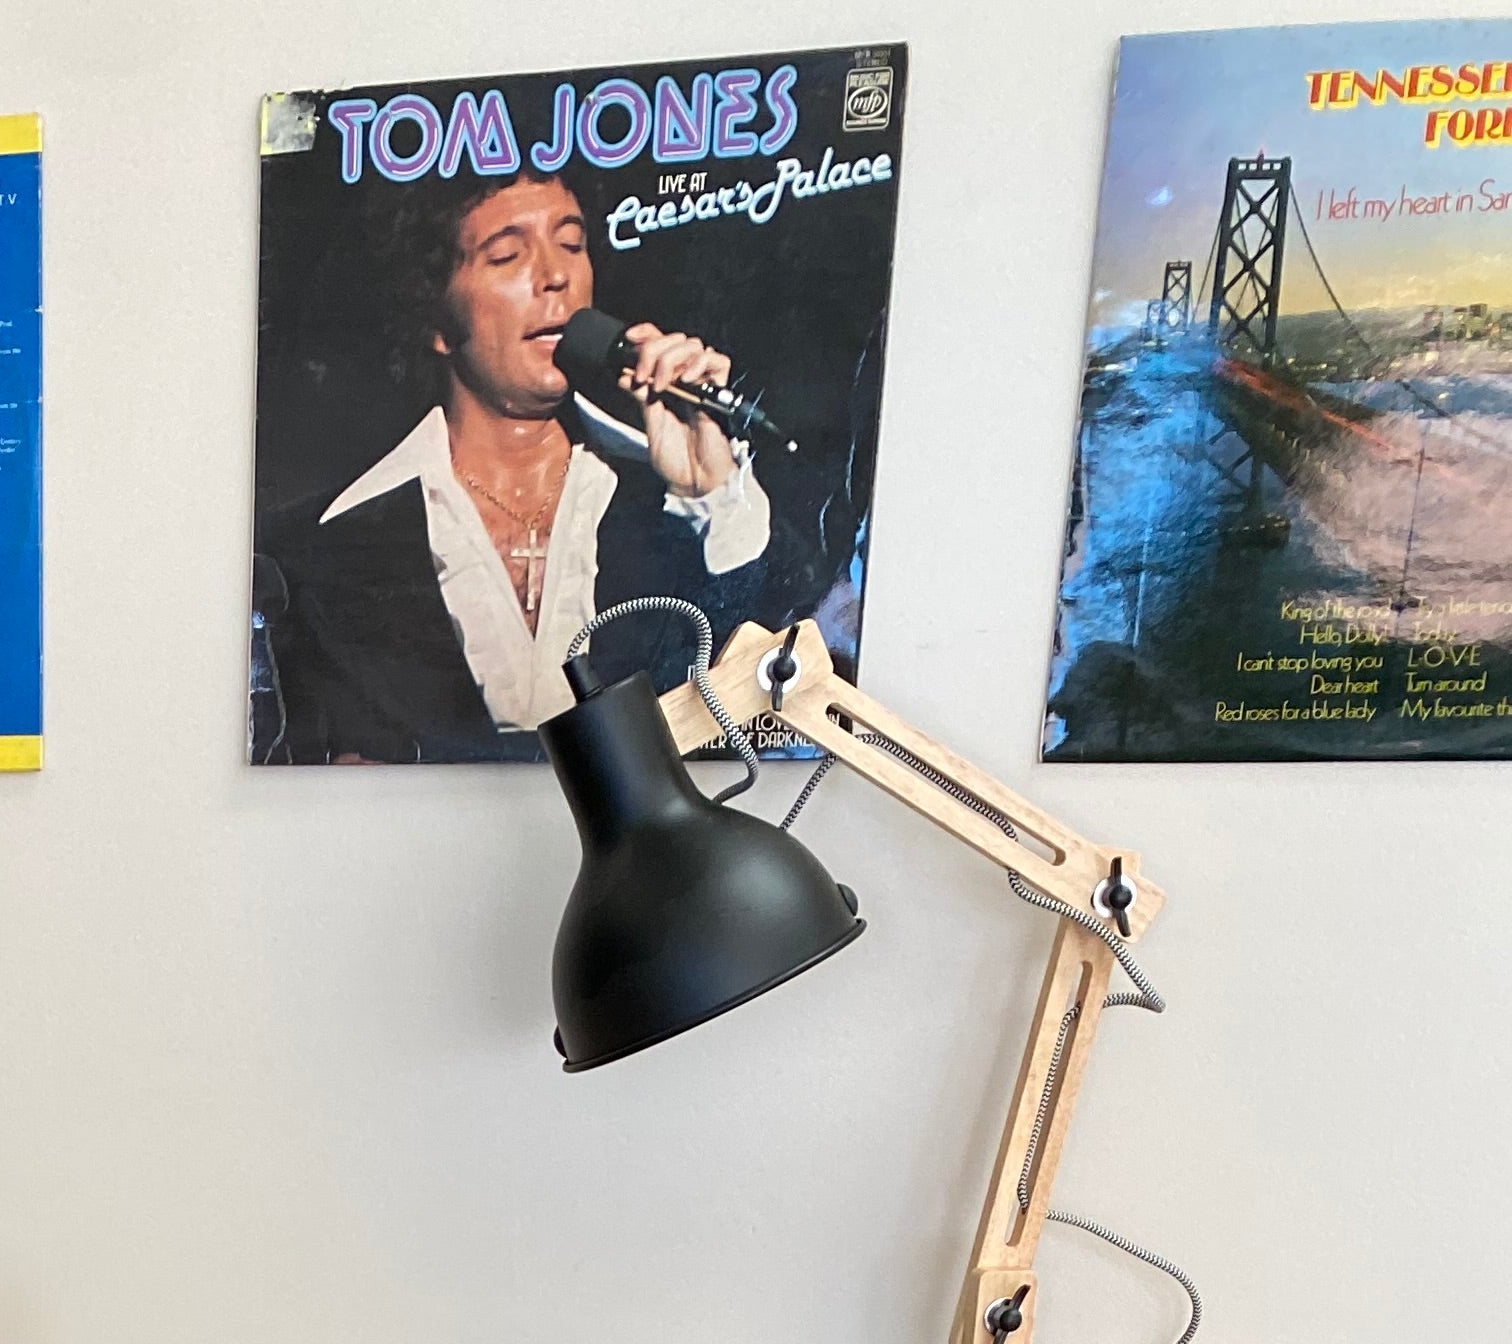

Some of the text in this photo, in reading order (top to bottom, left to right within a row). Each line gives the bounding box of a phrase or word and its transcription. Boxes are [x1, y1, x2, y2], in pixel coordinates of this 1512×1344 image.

[853, 89, 882, 113] mfp
[327, 64, 798, 184] TOM JONES
[658, 171, 707, 195] LIVE AT
[8, 193, 17, 205] V
[605, 146, 892, 251] Caesar's Palace
[1317, 189, 1323, 221] I
[1329, 186, 1360, 219] left
[1363, 198, 1396, 222] my
[1399, 185, 1451, 216] heart
[1456, 189, 1473, 213] in
[1281, 601, 1312, 622] King
[1244, 651, 1273, 671] can't
[1278, 656, 1308, 673] stop
[1311, 650, 1351, 672] loving
[1355, 657, 1383, 671] you
[1310, 674, 1379, 694] Dear heart
[1215, 699, 1376, 722] Red roses for a blue lady
[1400, 699, 1432, 721] My
